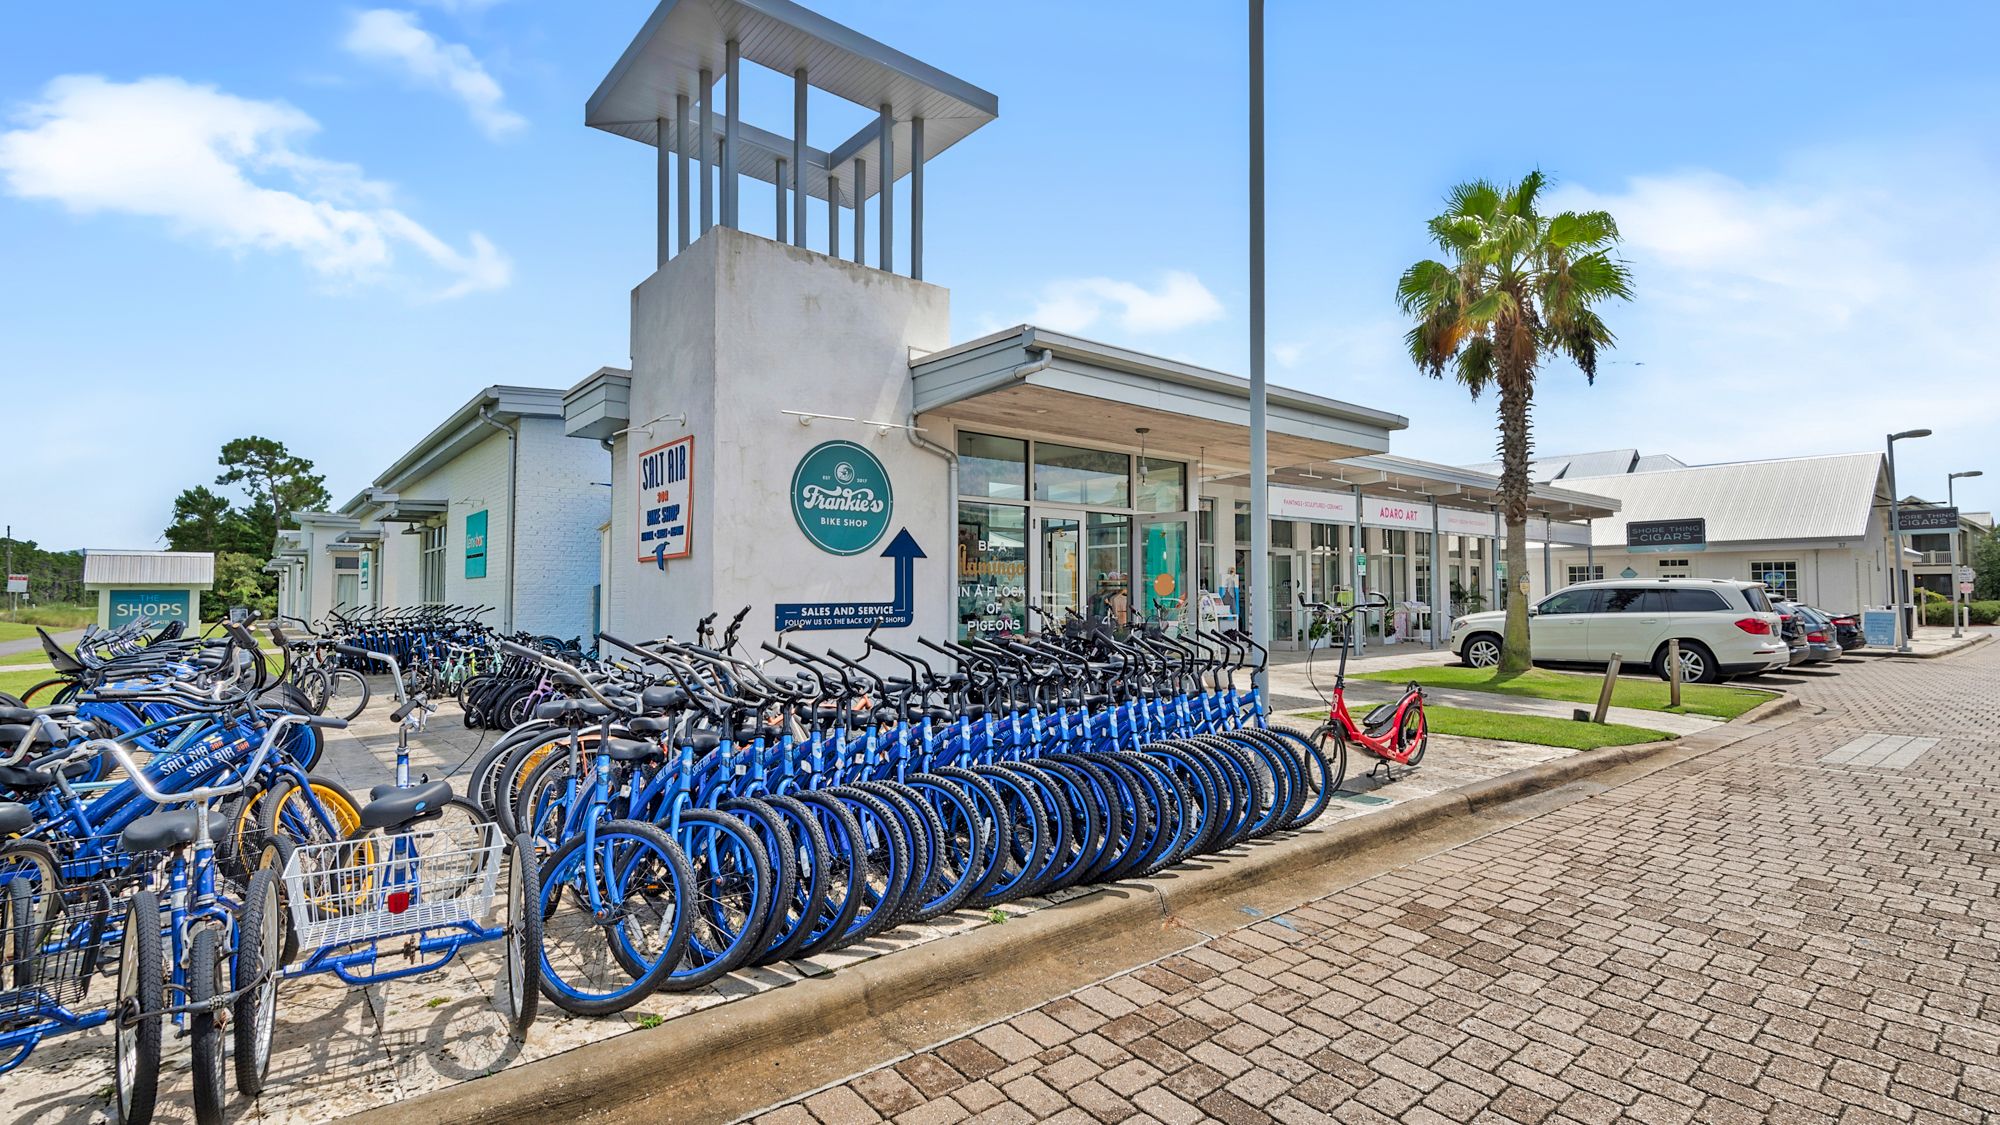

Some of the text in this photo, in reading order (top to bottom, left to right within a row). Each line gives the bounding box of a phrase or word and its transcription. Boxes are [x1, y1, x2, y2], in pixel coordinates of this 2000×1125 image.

[643, 445, 686, 490] SALT AIR
[1379, 507, 1418, 521] ADARO ART
[820, 517, 868, 527] BIKE SHOP
[1900, 518, 1948, 526] CIGARS
[1632, 525, 1700, 535] SHORE THING
[1640, 532, 1692, 541] CIGARS
[978, 540, 1007, 552] BE A
[958, 586, 1025, 597] IN A FLOCK
[140, 594, 161, 602] THE
[116, 603, 182, 617] SHOPS
[801, 606, 894, 617] SALES AND SERVICE
[986, 603, 1002, 614] OF
[813, 618, 822, 626] US
[834, 617, 845, 625] THE
[864, 616, 872, 624] OF
[967, 619, 1021, 632] PIGEONS
[159, 755, 187, 776] SALT
[188, 744, 209, 763] AIR
[186, 757, 214, 778] SALT
[214, 745, 236, 763] AIR
